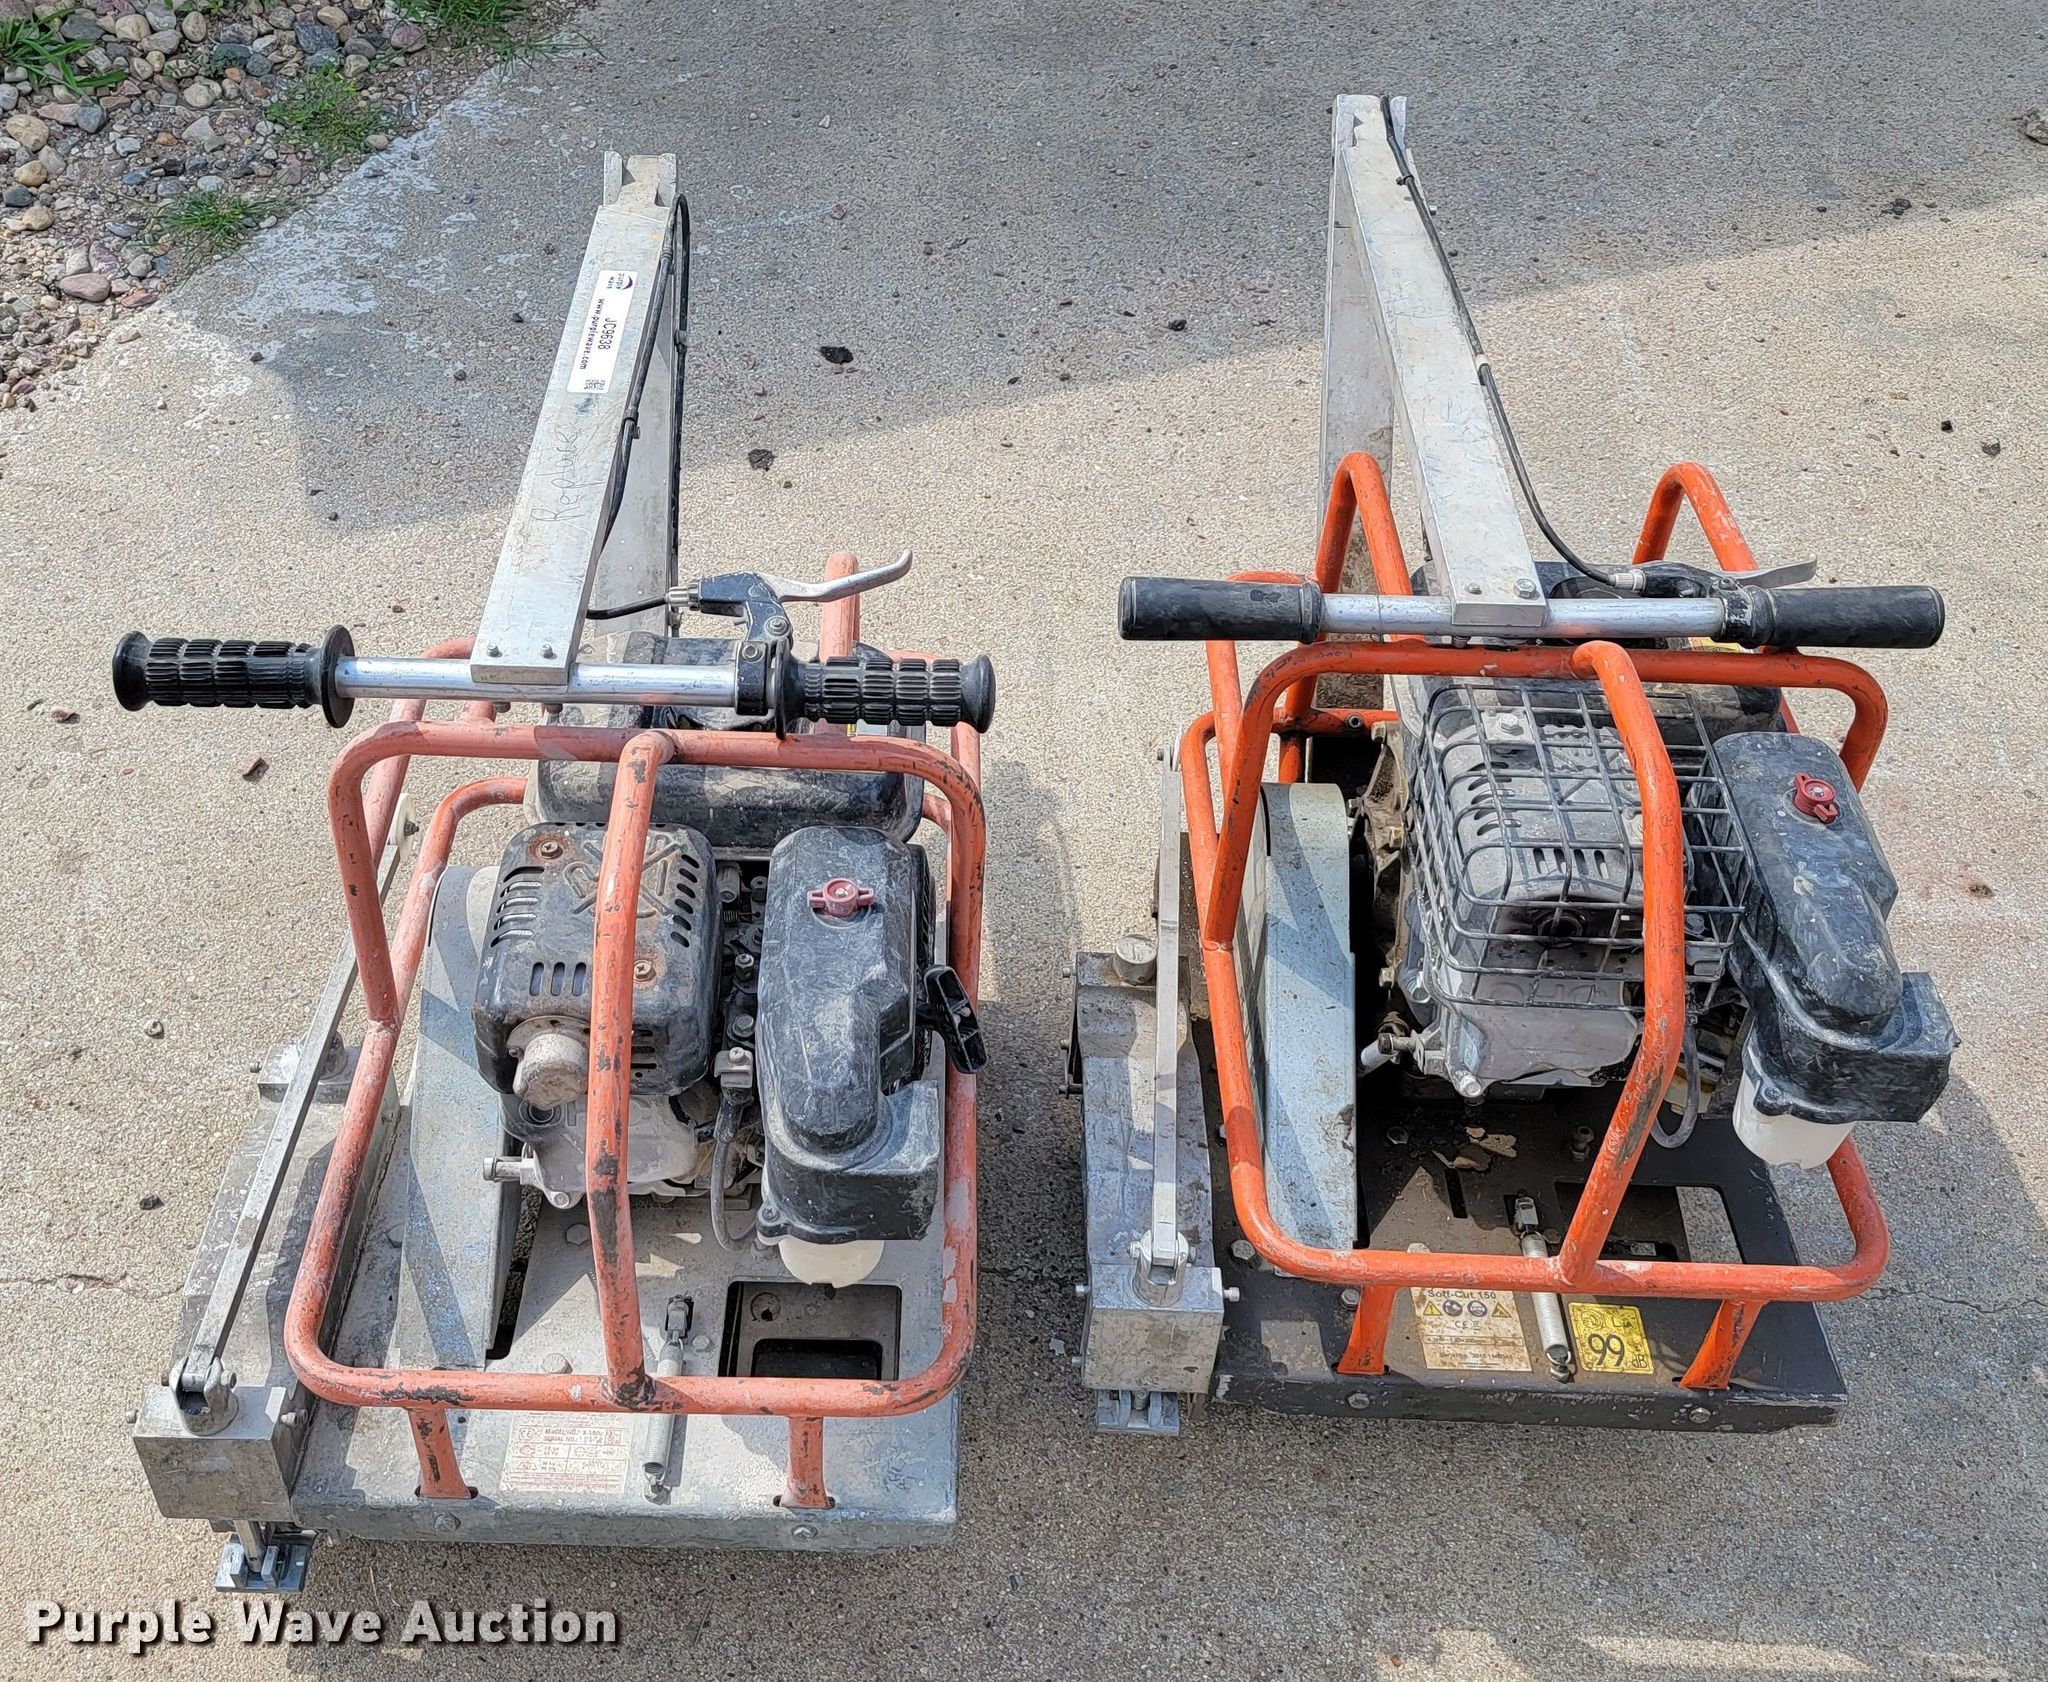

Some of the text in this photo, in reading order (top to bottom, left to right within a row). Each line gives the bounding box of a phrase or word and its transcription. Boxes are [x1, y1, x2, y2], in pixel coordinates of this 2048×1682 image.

[579, 298, 605, 370] www.purplewave.com
[597, 317, 618, 351] JC9638
[1477, 1291, 1497, 1300] 150
[1587, 1332, 1626, 1367] 99
